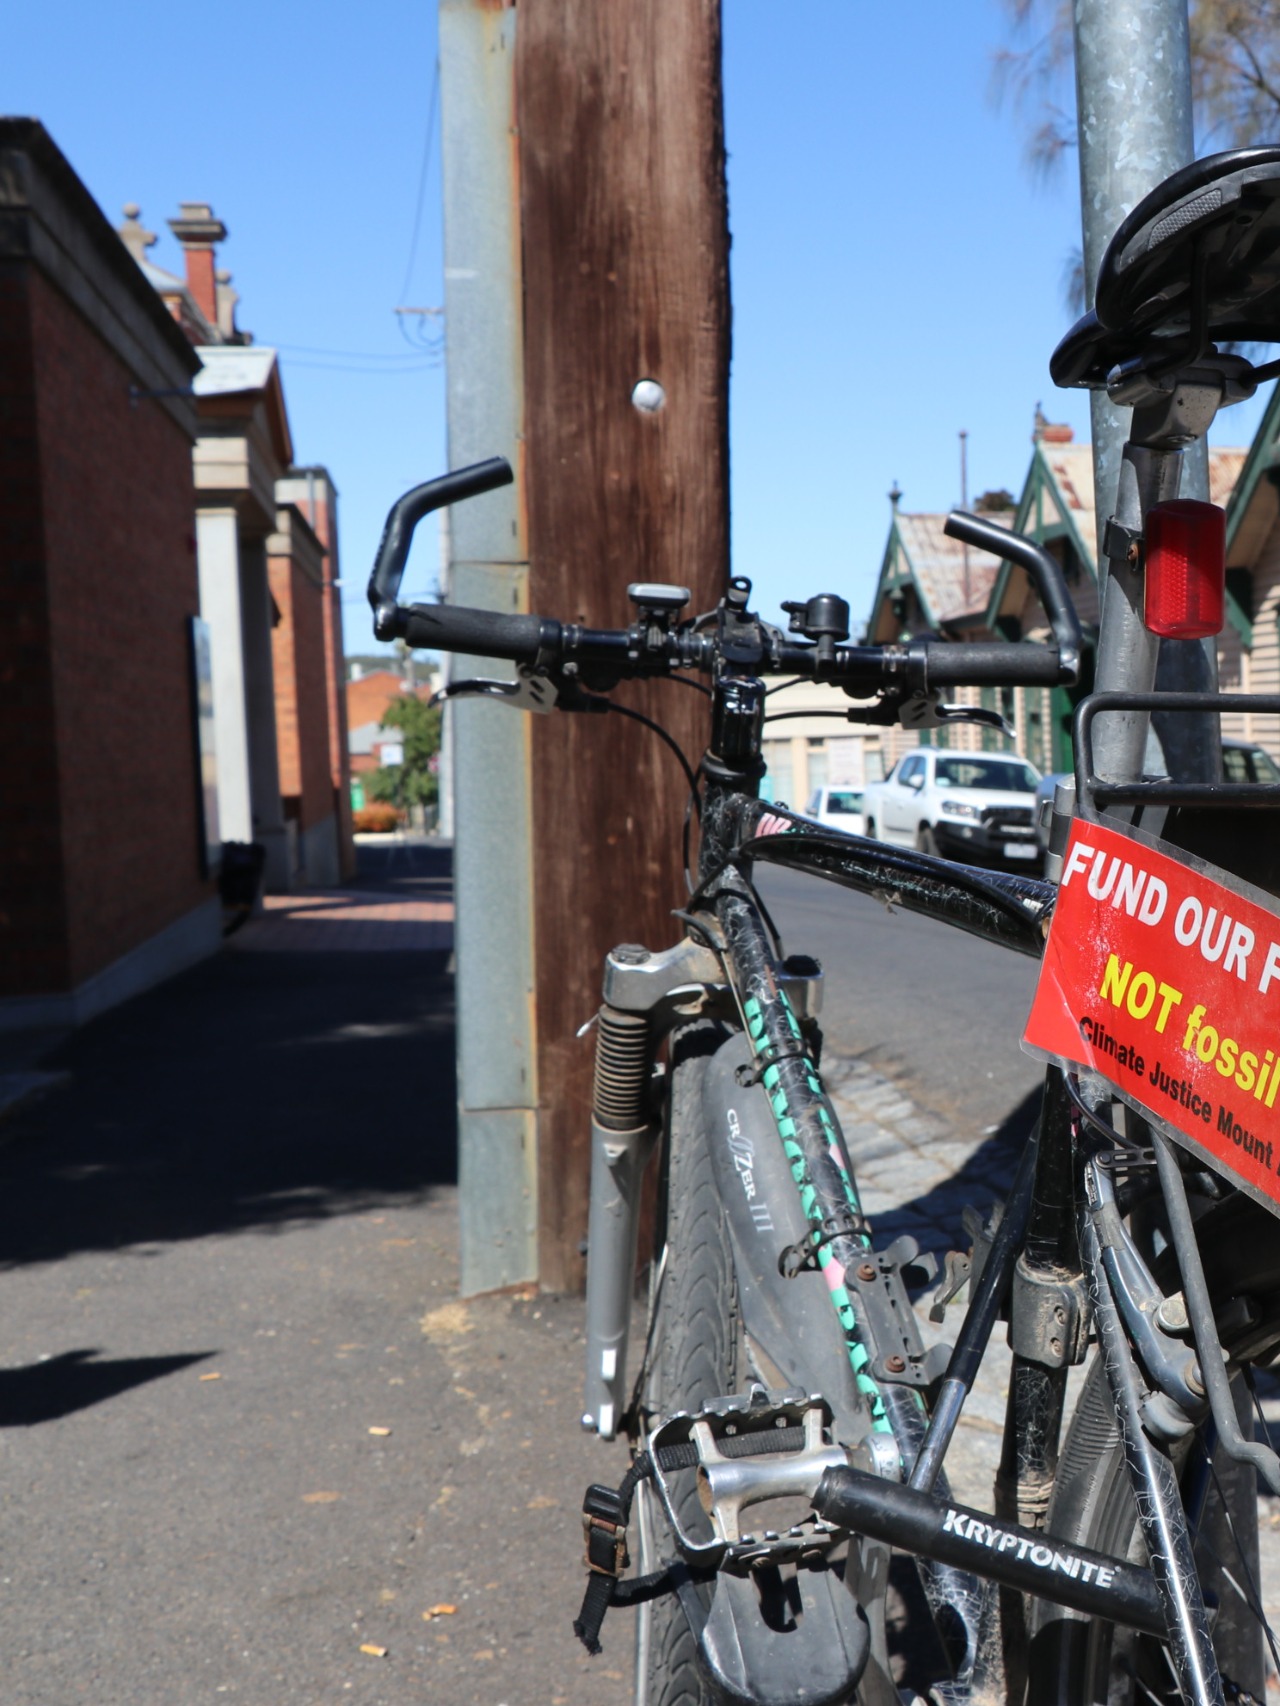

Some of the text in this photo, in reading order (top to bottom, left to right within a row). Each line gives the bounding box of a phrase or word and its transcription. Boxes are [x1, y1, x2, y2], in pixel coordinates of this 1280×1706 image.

[1061, 841, 1168, 927] FUND
[1173, 895, 1256, 982] OUR
[1100, 953, 1183, 1035] NOT
[1078, 1016, 1145, 1076] Climate
[1149, 1063, 1212, 1124] Justice
[1216, 1105, 1274, 1170] Mount
[942, 1510, 1116, 1588] KRYPTONITE
